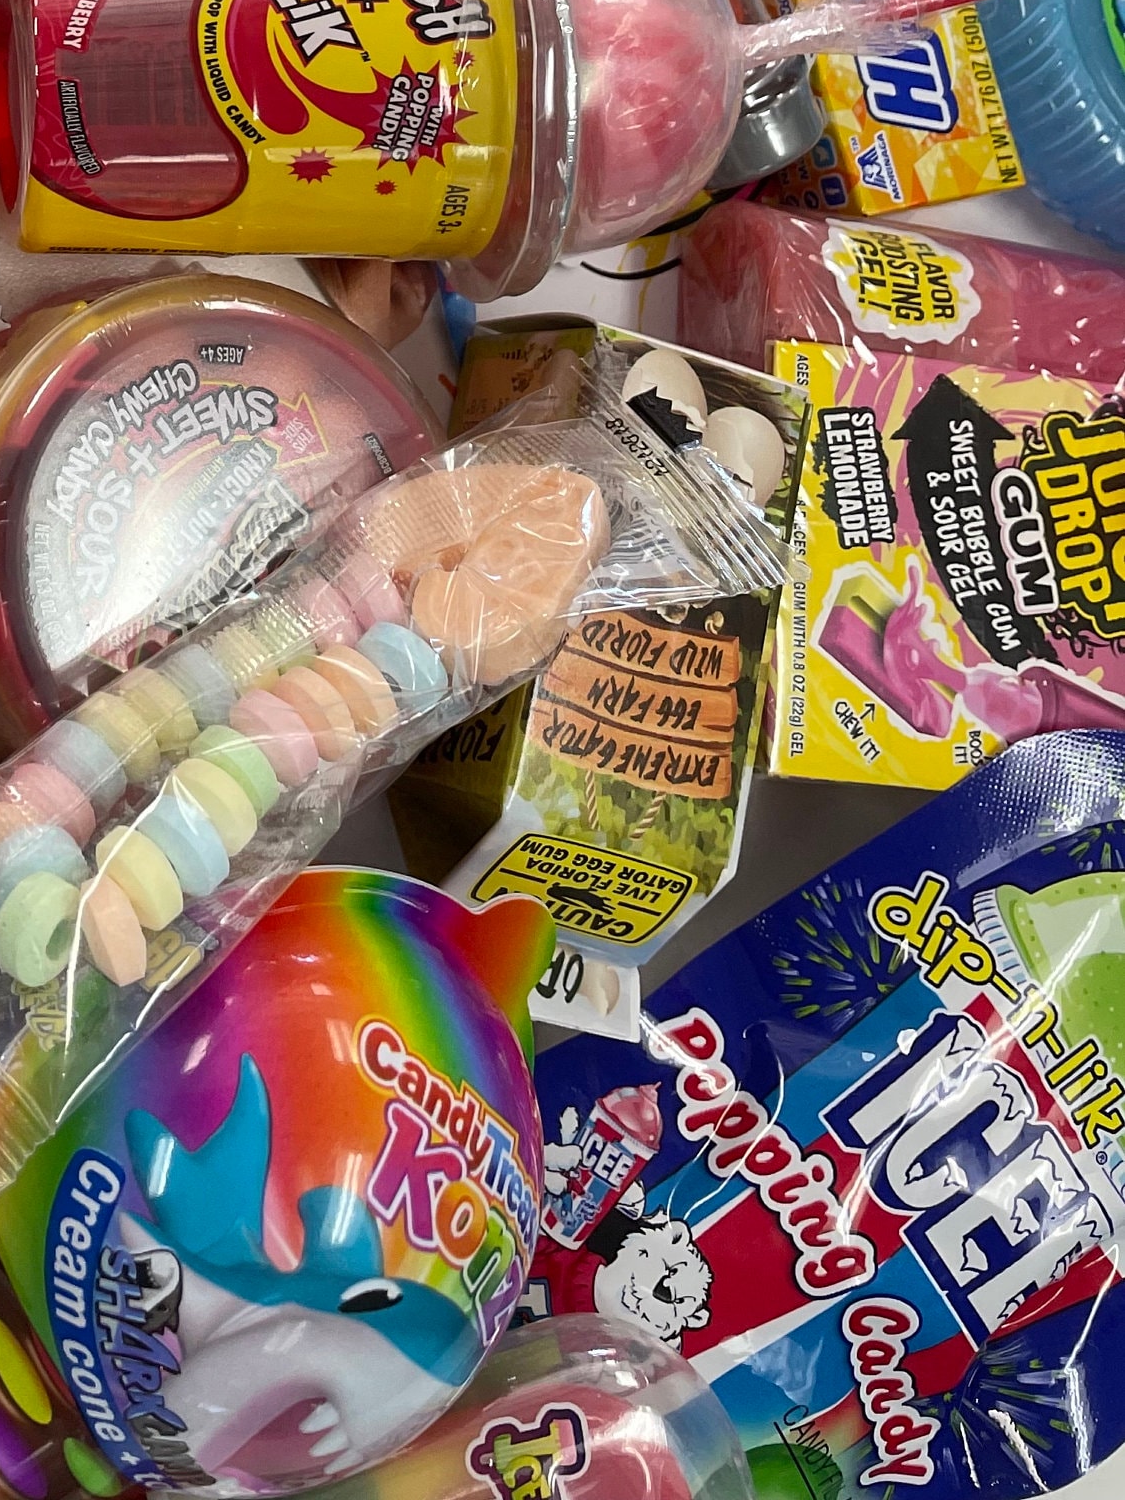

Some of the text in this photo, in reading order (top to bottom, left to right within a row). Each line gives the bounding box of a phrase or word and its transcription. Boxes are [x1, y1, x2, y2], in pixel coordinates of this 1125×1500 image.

[59, 80, 87, 132] ARTIFICIALLY
[204, 50, 268, 146] LIQUID CANDY
[372, 76, 410, 150] CANDY!
[391, 73, 435, 163] POPPING
[417, 104, 441, 146] WITH
[962, 7, 1019, 184] NET WT (50g)
[877, 132, 902, 201] MORINAGA
[437, 184, 470, 235] AGES 3+
[880, 230, 927, 322] BOOSTING
[915, 242, 957, 321] FLAVOR
[215, 346, 245, 364] AGES
[796, 353, 809, 387] AGES
[108, 361, 200, 431] CHEWY
[151, 387, 279, 454] SWEET
[43, 418, 115, 528] CANDY
[823, 411, 870, 547] LEMONADE
[851, 411, 894, 543] STRAWBERRY
[928, 495, 979, 608] SOUR GEL
[949, 419, 1021, 652] SWEET BUBBLE GUM
[997, 472, 1058, 612] GUM
[581, 615, 725, 680] WILD FLORID
[789, 612, 806, 758] WITH (22g) GEL
[588, 676, 703, 732] EGG FARM
[833, 700, 866, 741] CHEW
[541, 707, 721, 788] EXTREME GATOR
[519, 838, 684, 895] GATOR EGG GUM
[525, 856, 662, 905] LIVE FLORIDA
[871, 874, 1125, 1148] dip-n-lik
[361, 1022, 491, 1177] Candy
[579, 1128, 633, 1188] ICEE
[655, 1012, 878, 1297] Popping
[53, 1159, 127, 1444] Cream cone
[845, 1302, 934, 1487] Candy
